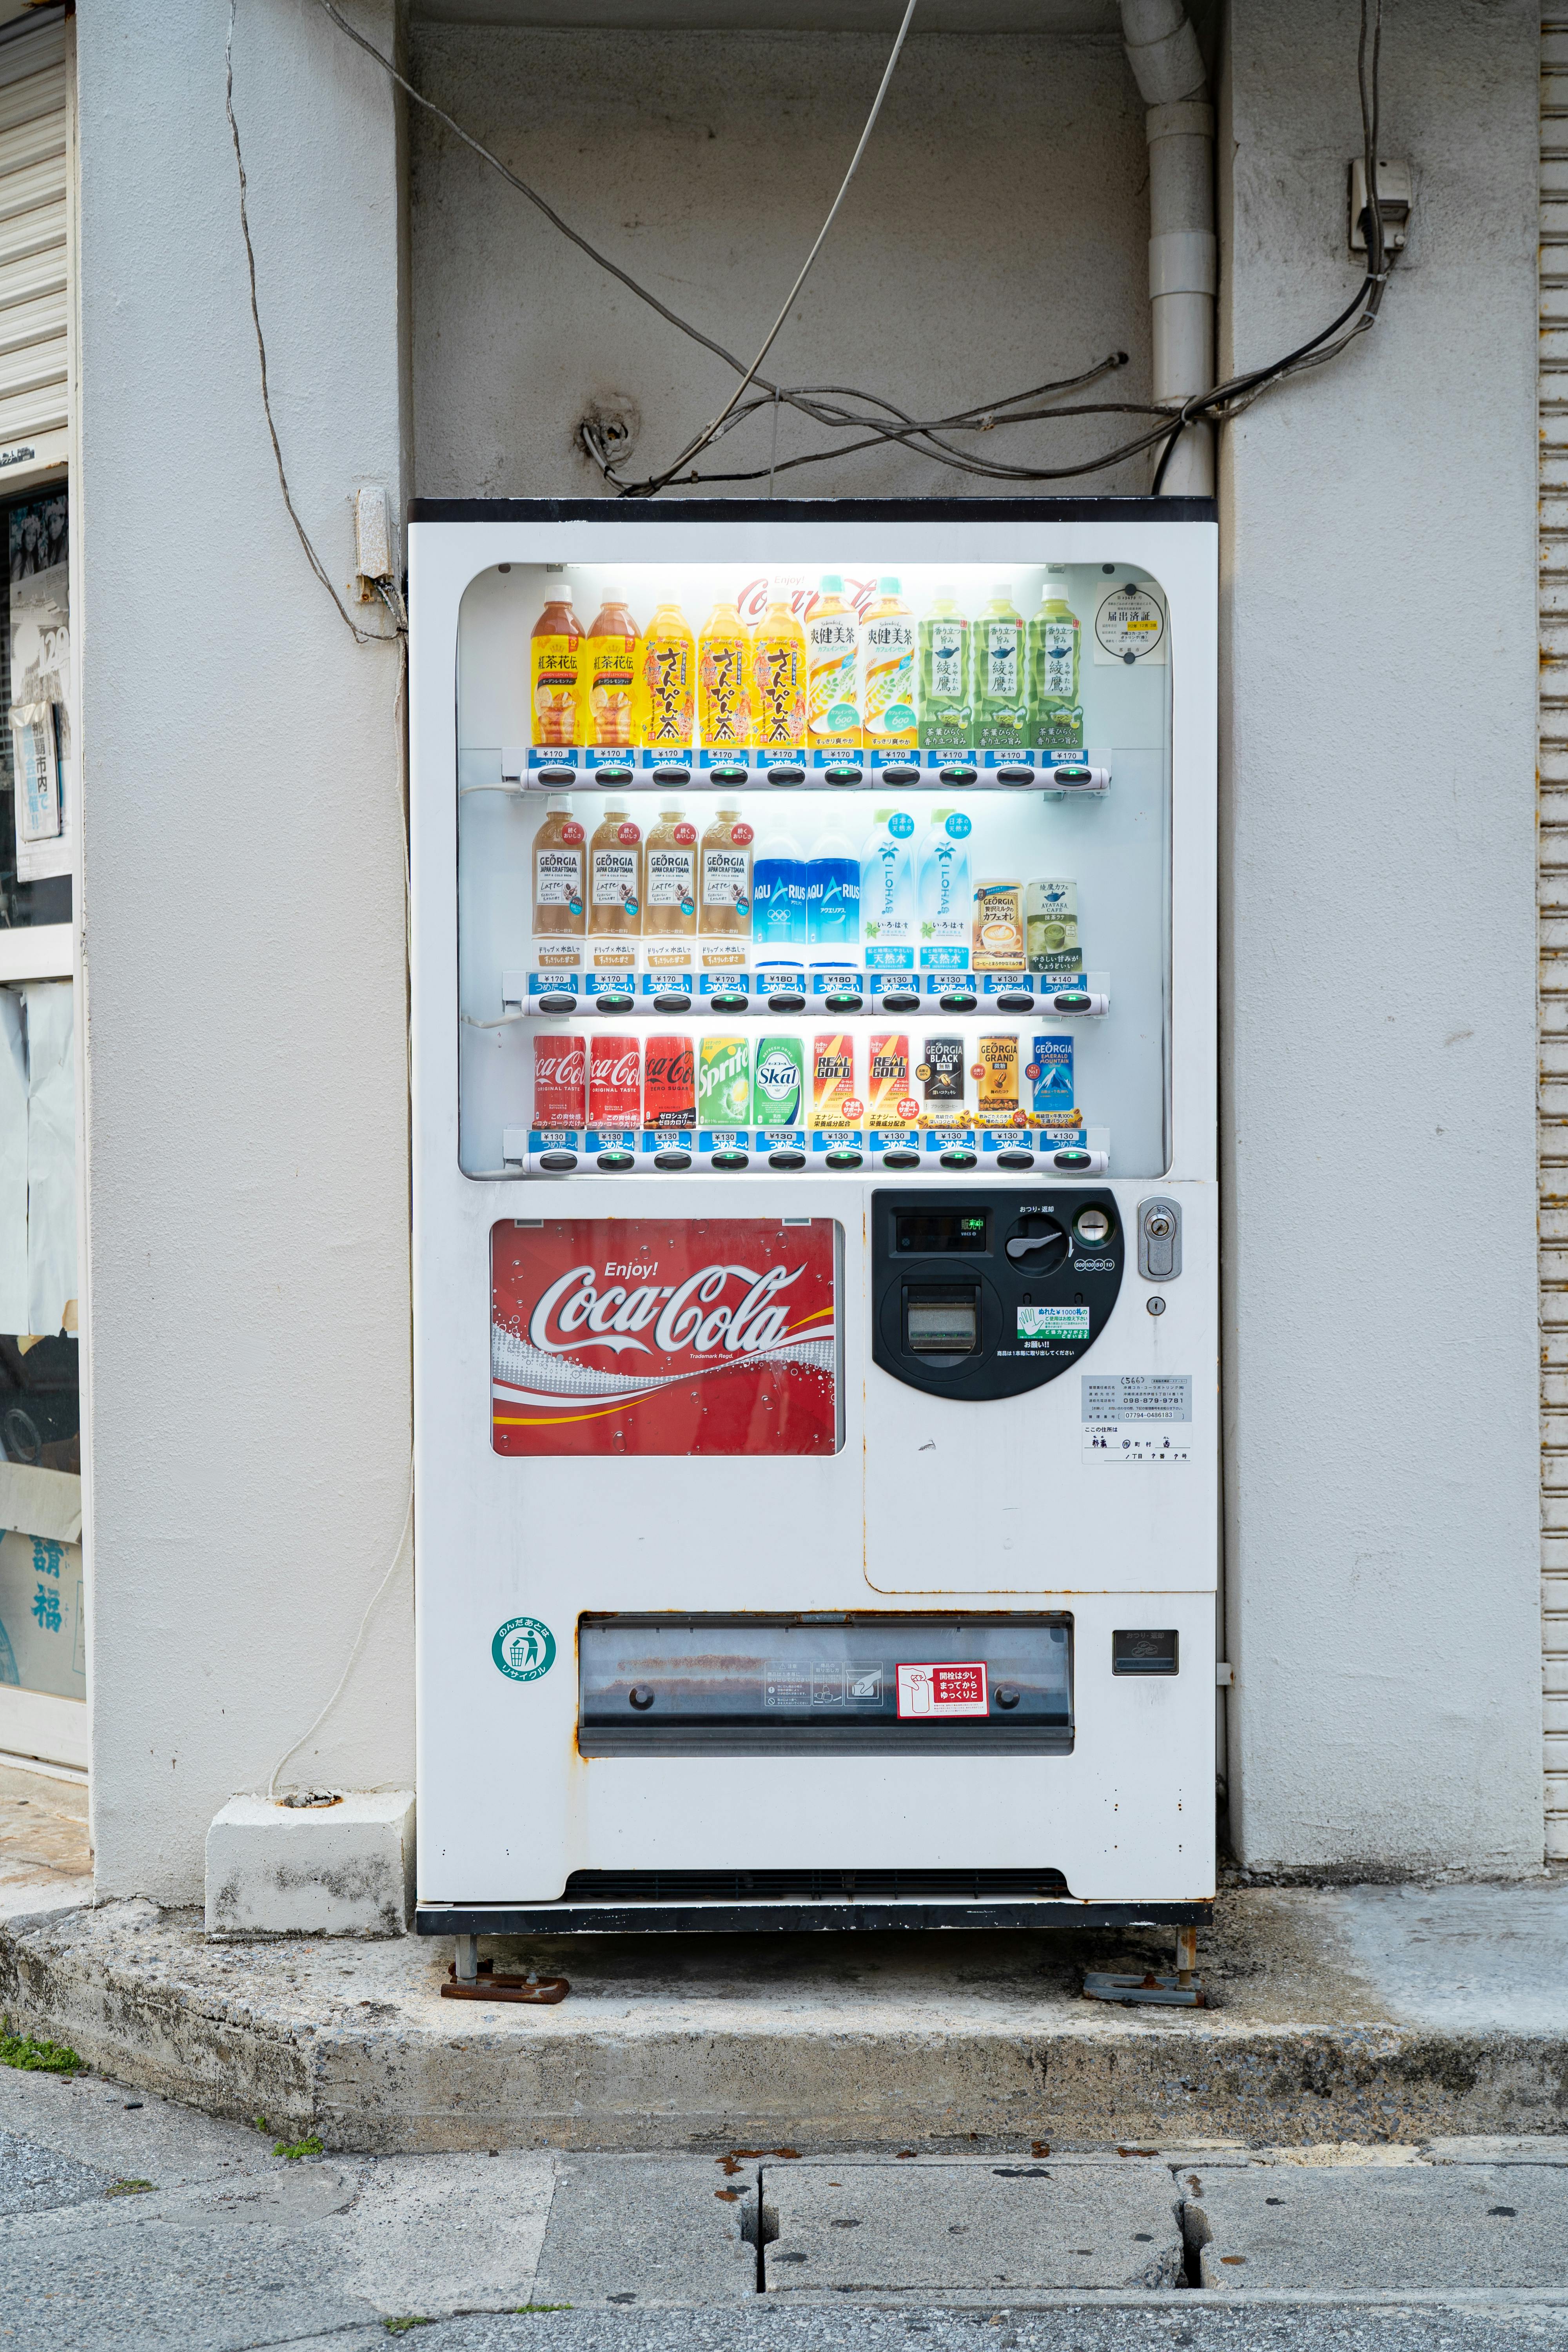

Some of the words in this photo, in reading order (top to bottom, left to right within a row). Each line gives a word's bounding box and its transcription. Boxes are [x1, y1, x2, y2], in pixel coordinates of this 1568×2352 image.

[1108, 612, 1150, 621] 届出済証
[811, 627, 855, 645] 爽健美茶
[868, 628, 912, 645] 爽健美茶
[1047, 626, 1073, 635] 香り立つ
[940, 636, 954, 644] 旨み
[1053, 635, 1066, 644] 旨み
[538, 655, 577, 670] 紅茶花伝
[594, 655, 633, 670] 紅茶花伝
[936, 661, 951, 692] 綾鷹
[992, 661, 1007, 692] 綾鷹
[1049, 660, 1063, 692] 綾鷹
[655, 648, 681, 740] さんぴん茶
[711, 648, 736, 741] さんぴん茶
[766, 648, 790, 742] さんぴん茶
[924, 737, 966, 746] 香り立つ旨み
[1037, 736, 1078, 745] 香り立つ旨み
[540, 853, 577, 866] GEORGIA
[596, 853, 633, 866] GEORGIA
[651, 854, 690, 866] GEORGIA
[754, 877, 805, 907] AQUARIUS
[807, 876, 859, 906] AQUARIUS
[984, 897, 1014, 905] GEORGIA
[874, 954, 906, 964] 天然水
[763, 1046, 780, 1058] REFRESH
[781, 1047, 793, 1058] DRINK
[926, 1042, 963, 1054] GEORGIA
[981, 1042, 1017, 1054] GEORGIA
[1036, 1041, 1072, 1053] GEORGIA
[818, 1052, 850, 1067] REAL
[873, 1052, 906, 1067] REAL
[699, 1047, 748, 1098] Sprite
[817, 1067, 850, 1079] GOLD
[873, 1067, 905, 1079] GOLD
[961, 1219, 983, 1230] 販売中
[604, 1262, 658, 1279] Enjoy!
[529, 1261, 808, 1356] Coca-Cola
[499, 1618, 550, 1638] のんだあとは
[502, 1664, 546, 1680] リサイクル
[939, 1671, 976, 1680] 開栓は少し
[940, 1681, 977, 1690] まってから
[940, 1691, 977, 1699] ゆっくりと
